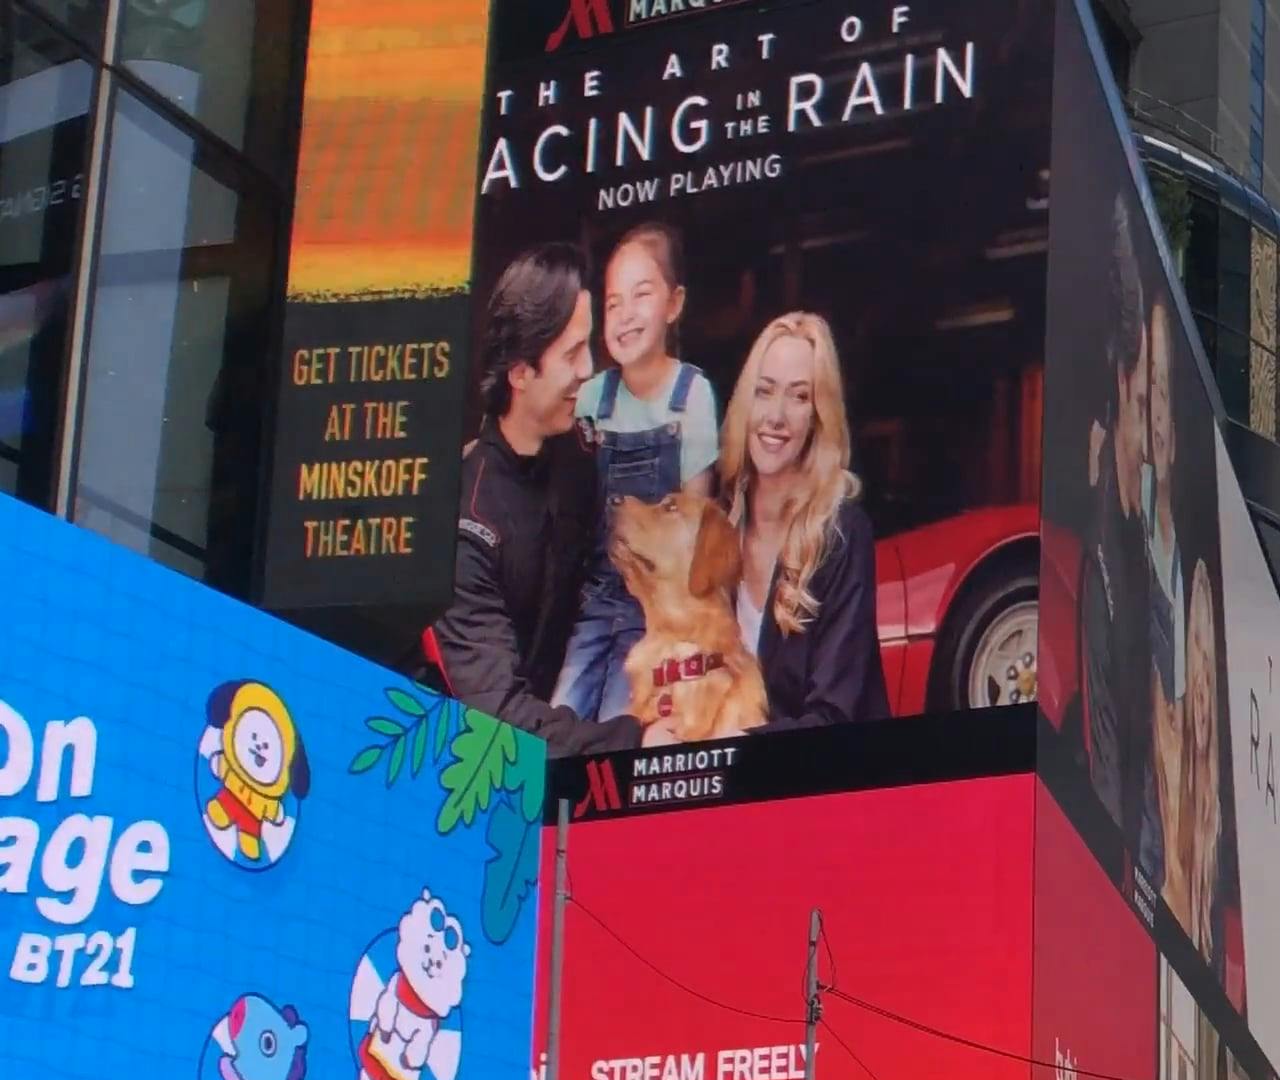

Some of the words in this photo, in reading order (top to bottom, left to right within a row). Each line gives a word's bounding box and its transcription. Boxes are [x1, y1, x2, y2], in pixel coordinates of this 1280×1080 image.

[496, 68, 602, 116] THE
[662, 32, 777, 80] ART
[841, 5, 910, 42] OF
[735, 90, 761, 111] IN
[786, 41, 975, 134] RAIN
[481, 96, 709, 194] ACING
[725, 115, 771, 143] THE
[599, 178, 658, 211] NOW
[669, 154, 783, 199] PLAYING
[293, 345, 338, 386] GET
[348, 340, 451, 382] TICKETS
[325, 404, 357, 442] AT
[364, 402, 407, 439] THE
[299, 458, 428, 501] MINSKOFF
[304, 518, 414, 559] THEATRE
[633, 748, 736, 776] MARRIOTT
[632, 775, 723, 804] MARQUIS
[10, 927, 135, 989] BT21
